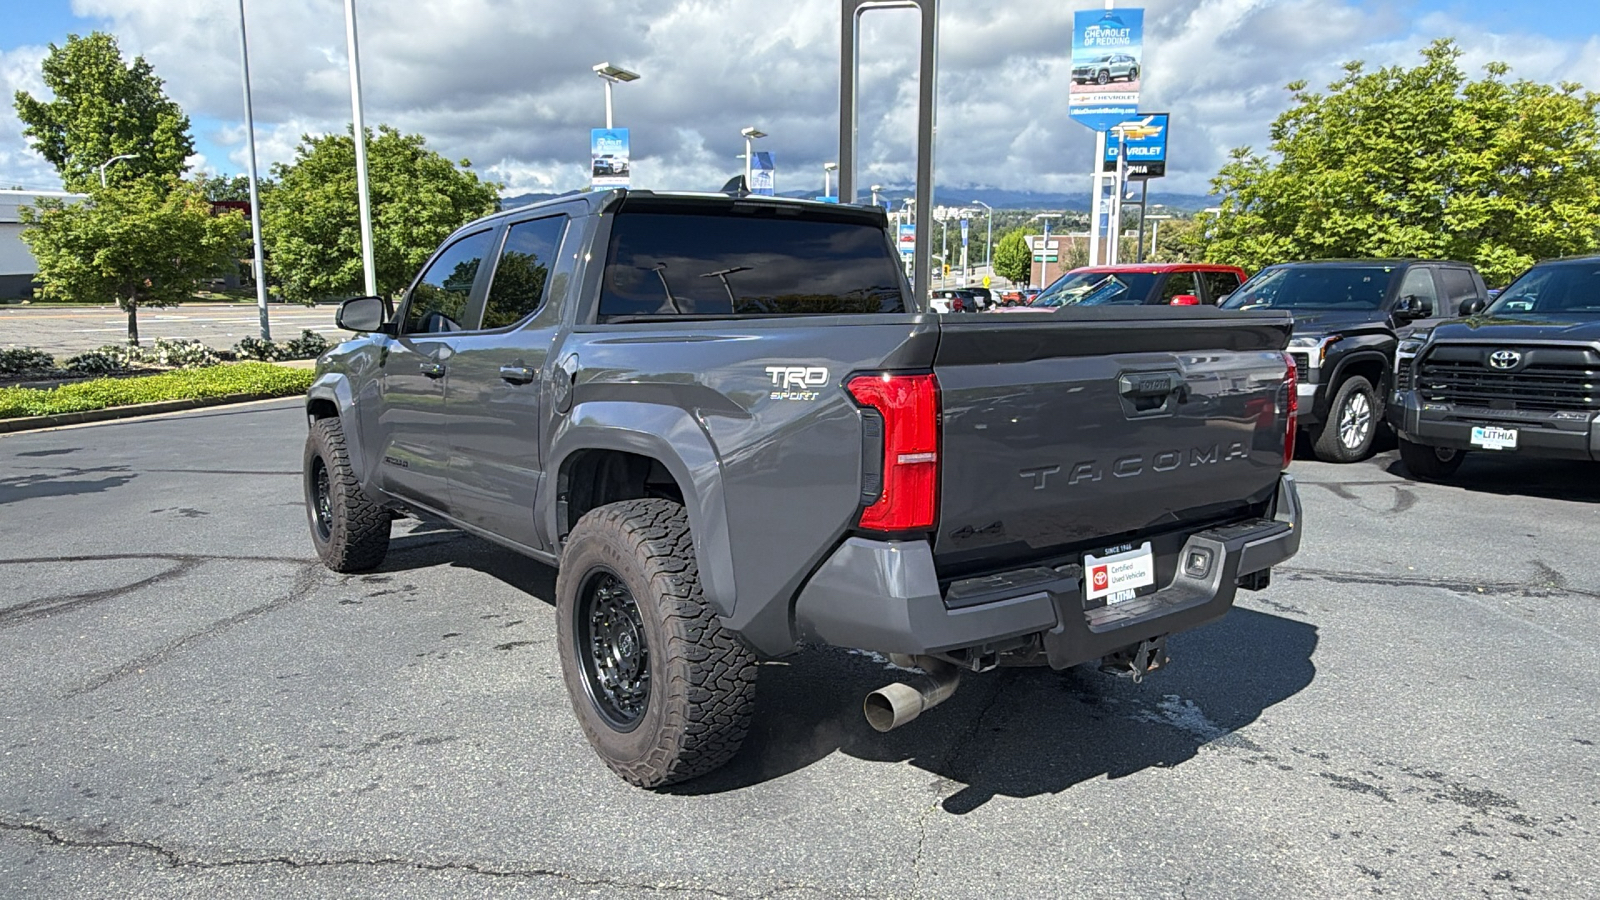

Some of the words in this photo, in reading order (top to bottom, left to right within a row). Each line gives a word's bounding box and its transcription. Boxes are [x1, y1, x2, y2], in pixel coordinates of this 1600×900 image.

[1084, 28, 1131, 38] CHEVROLET
[1084, 38, 1094, 47] OF
[1096, 37, 1131, 46] REDDING
[1107, 146, 1162, 156] CHVROLET
[765, 366, 829, 391] TRD
[770, 392, 820, 401] SPORT
[1482, 430, 1515, 441] LITHIA
[1019, 442, 1250, 490] TACOMA
[1104, 546, 1120, 555] SINCE
[1111, 563, 1134, 574] Certified
[1111, 576, 1125, 584] Used
[1125, 570, 1146, 580] Vehicles
